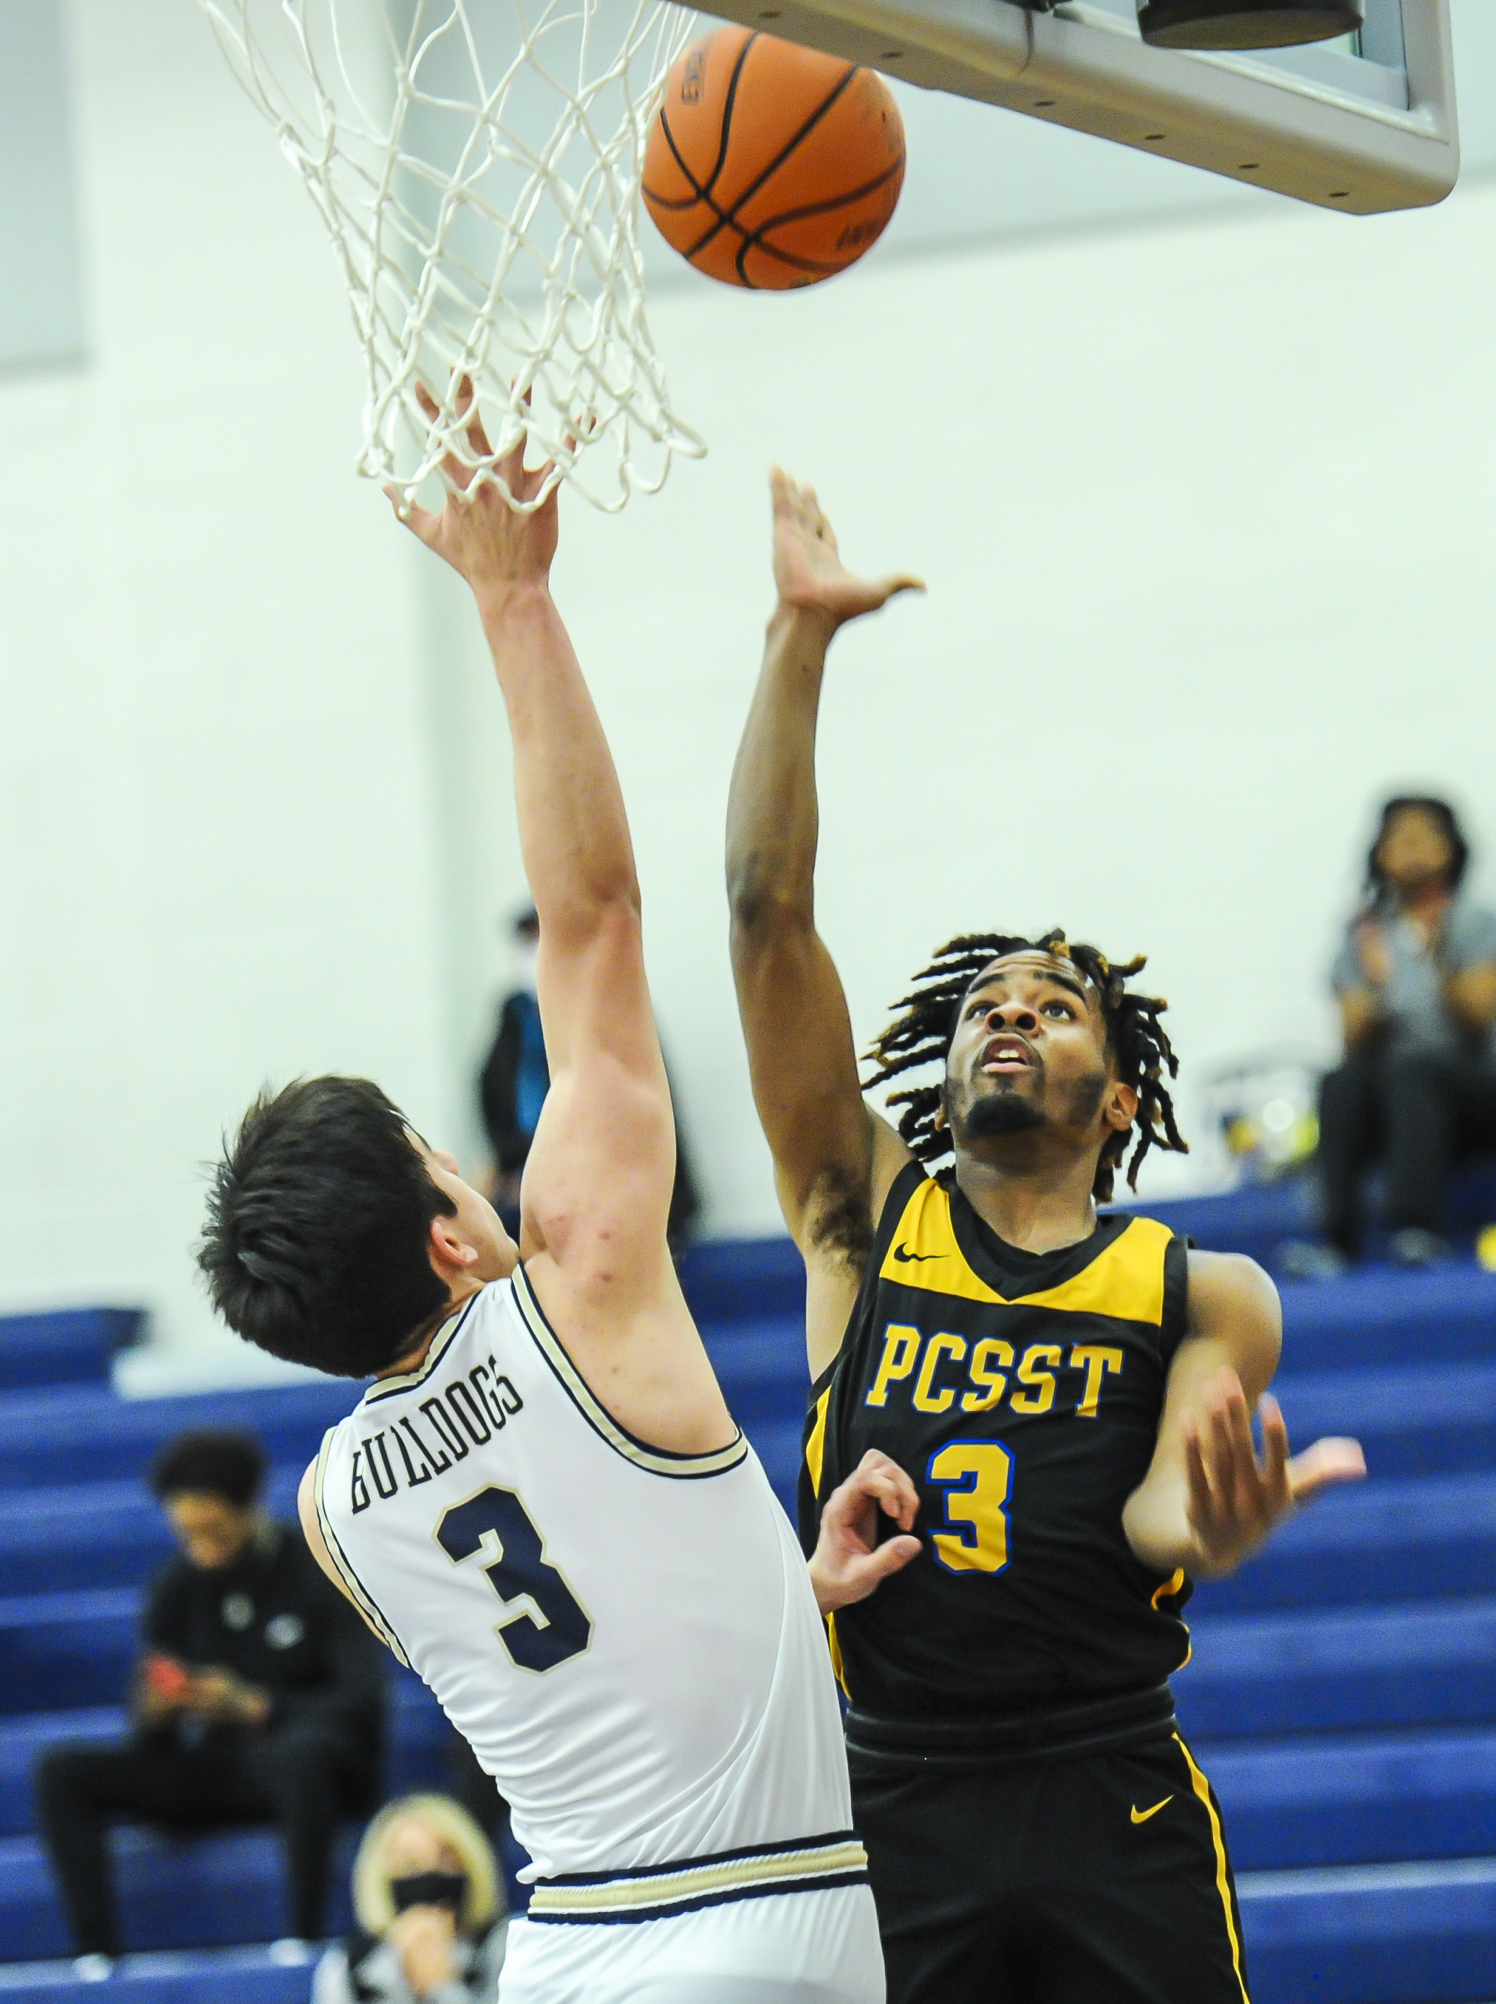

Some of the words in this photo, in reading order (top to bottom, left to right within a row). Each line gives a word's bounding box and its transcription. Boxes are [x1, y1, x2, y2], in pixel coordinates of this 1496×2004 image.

[864, 1321, 1123, 1419] PCSST
[925, 1438, 1016, 1577] 3
[431, 1482, 597, 1676] 3
